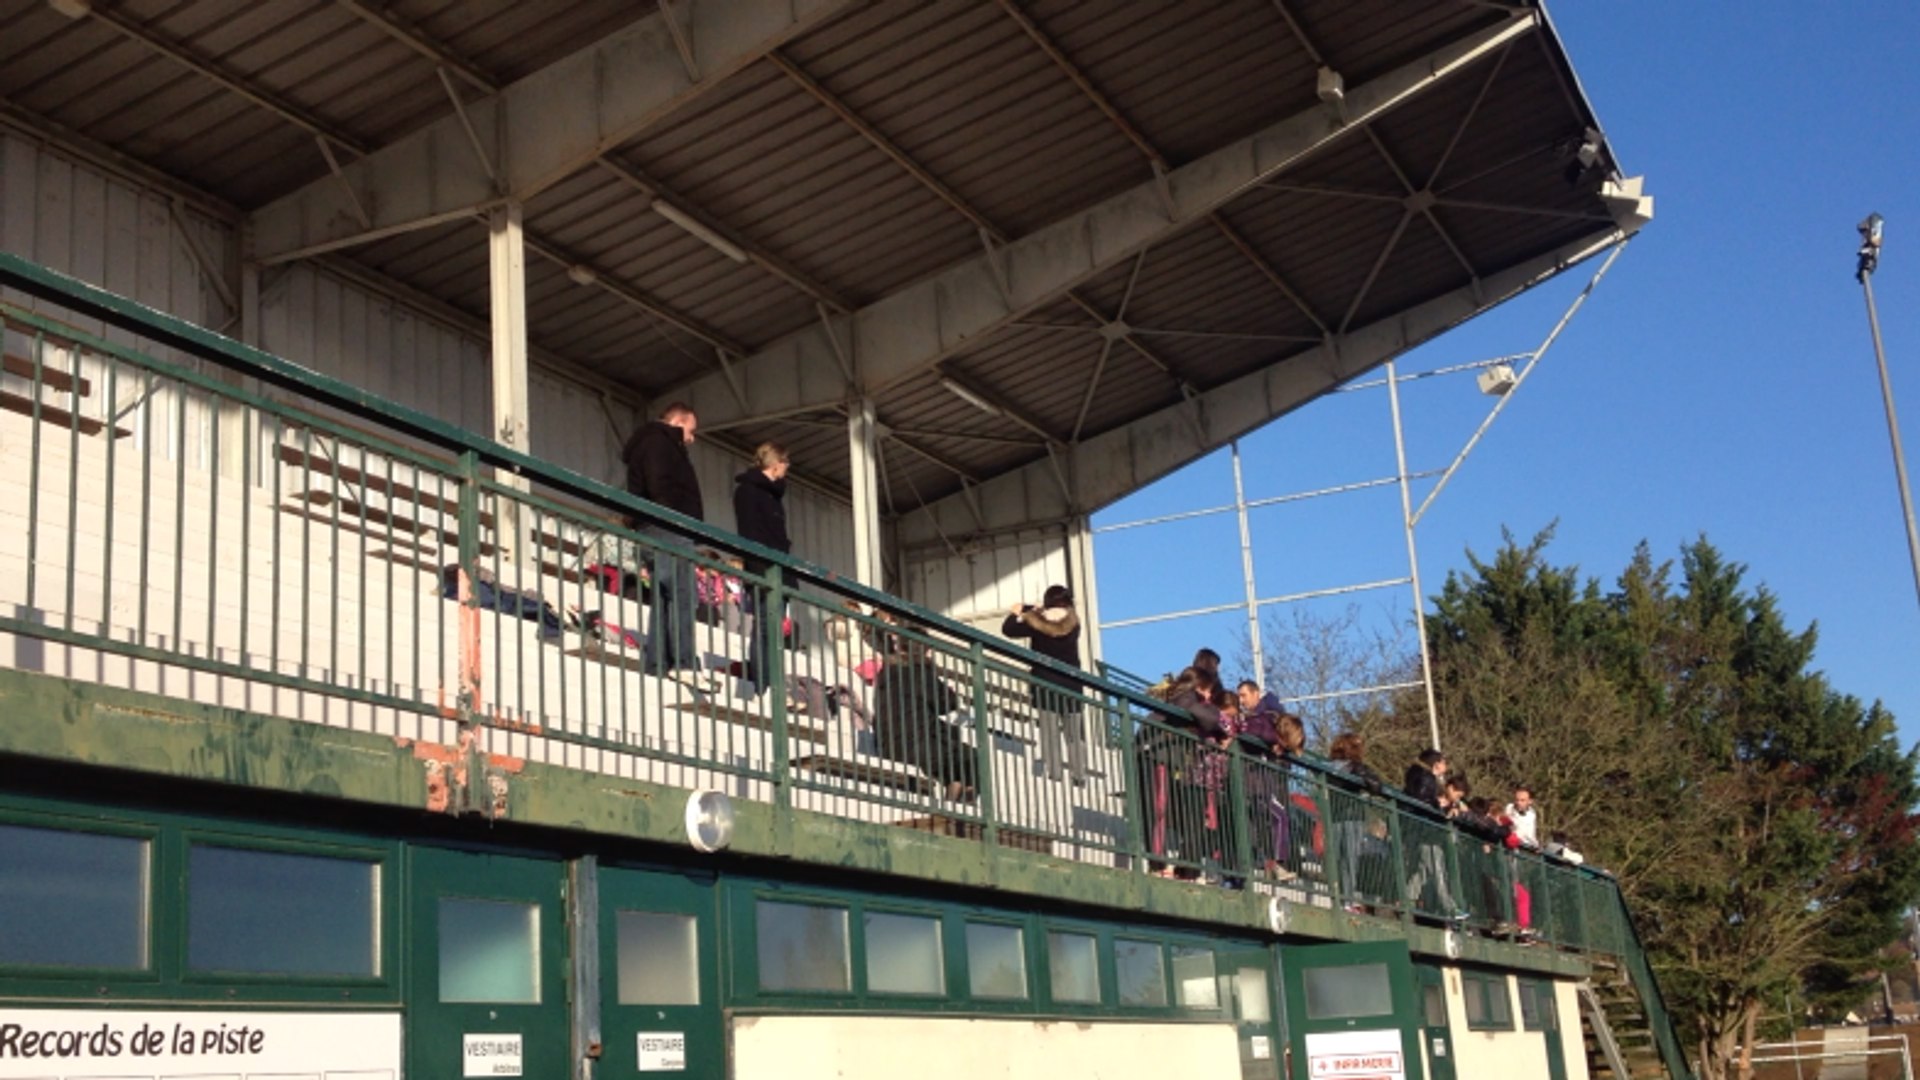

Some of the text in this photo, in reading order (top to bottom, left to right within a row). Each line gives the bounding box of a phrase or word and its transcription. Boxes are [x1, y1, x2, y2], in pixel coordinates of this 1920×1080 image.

[0, 1023, 265, 1058] Records de la piste
[639, 1038, 684, 1051] VESTIAIRE
[465, 1041, 521, 1056] VESTIAIRE
